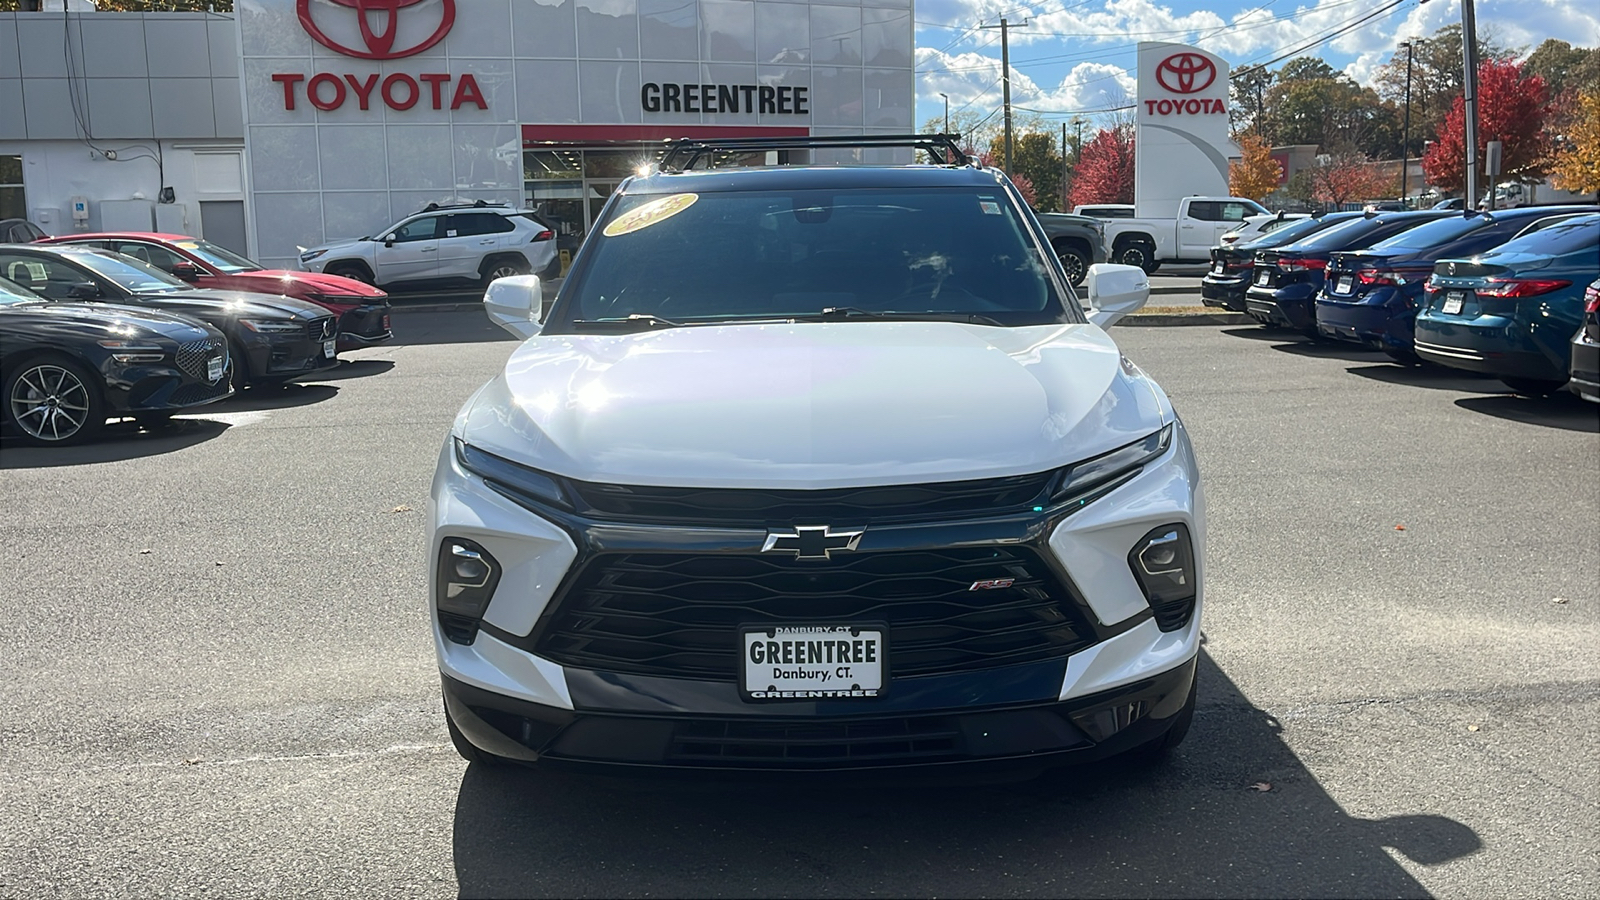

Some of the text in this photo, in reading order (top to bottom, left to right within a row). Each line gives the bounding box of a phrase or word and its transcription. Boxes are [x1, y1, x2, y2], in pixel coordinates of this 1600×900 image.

[271, 73, 489, 111] TOYOTA
[641, 82, 809, 114] GREENTREE
[1144, 98, 1226, 116] TOYOTA
[968, 578, 1015, 591] RS
[750, 640, 876, 664] GREENTREE
[773, 667, 853, 682] Danbury, CT.
[751, 690, 878, 698] GREENTREE
